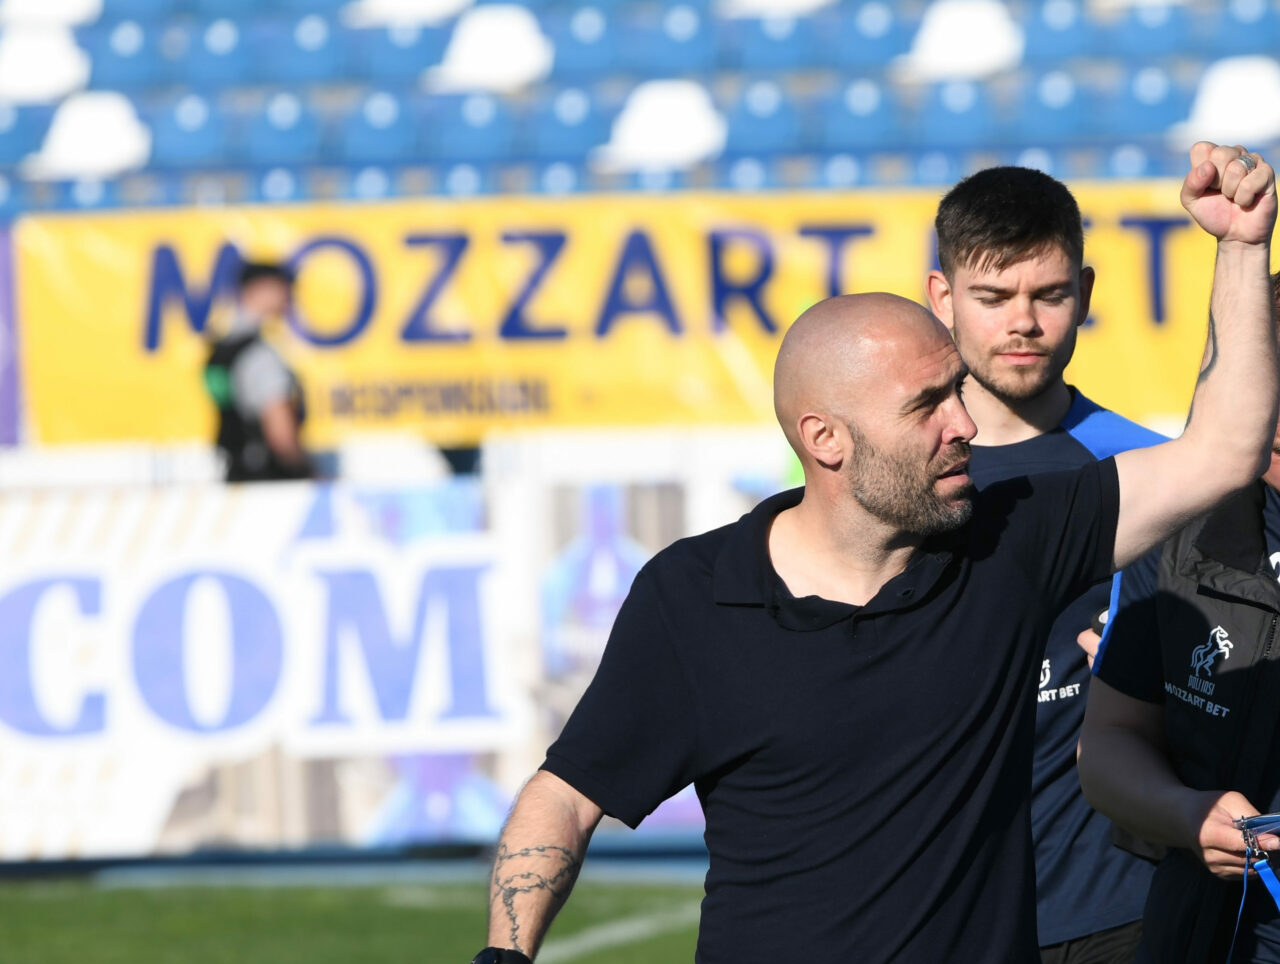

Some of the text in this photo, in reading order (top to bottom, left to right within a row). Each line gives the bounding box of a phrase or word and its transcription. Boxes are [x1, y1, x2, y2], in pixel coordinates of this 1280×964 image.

[143, 226, 875, 354] MOZZART
[0, 566, 506, 738] COM
[1059, 683, 1081, 699] BET
[1164, 681, 1231, 718] MOZZART BET
